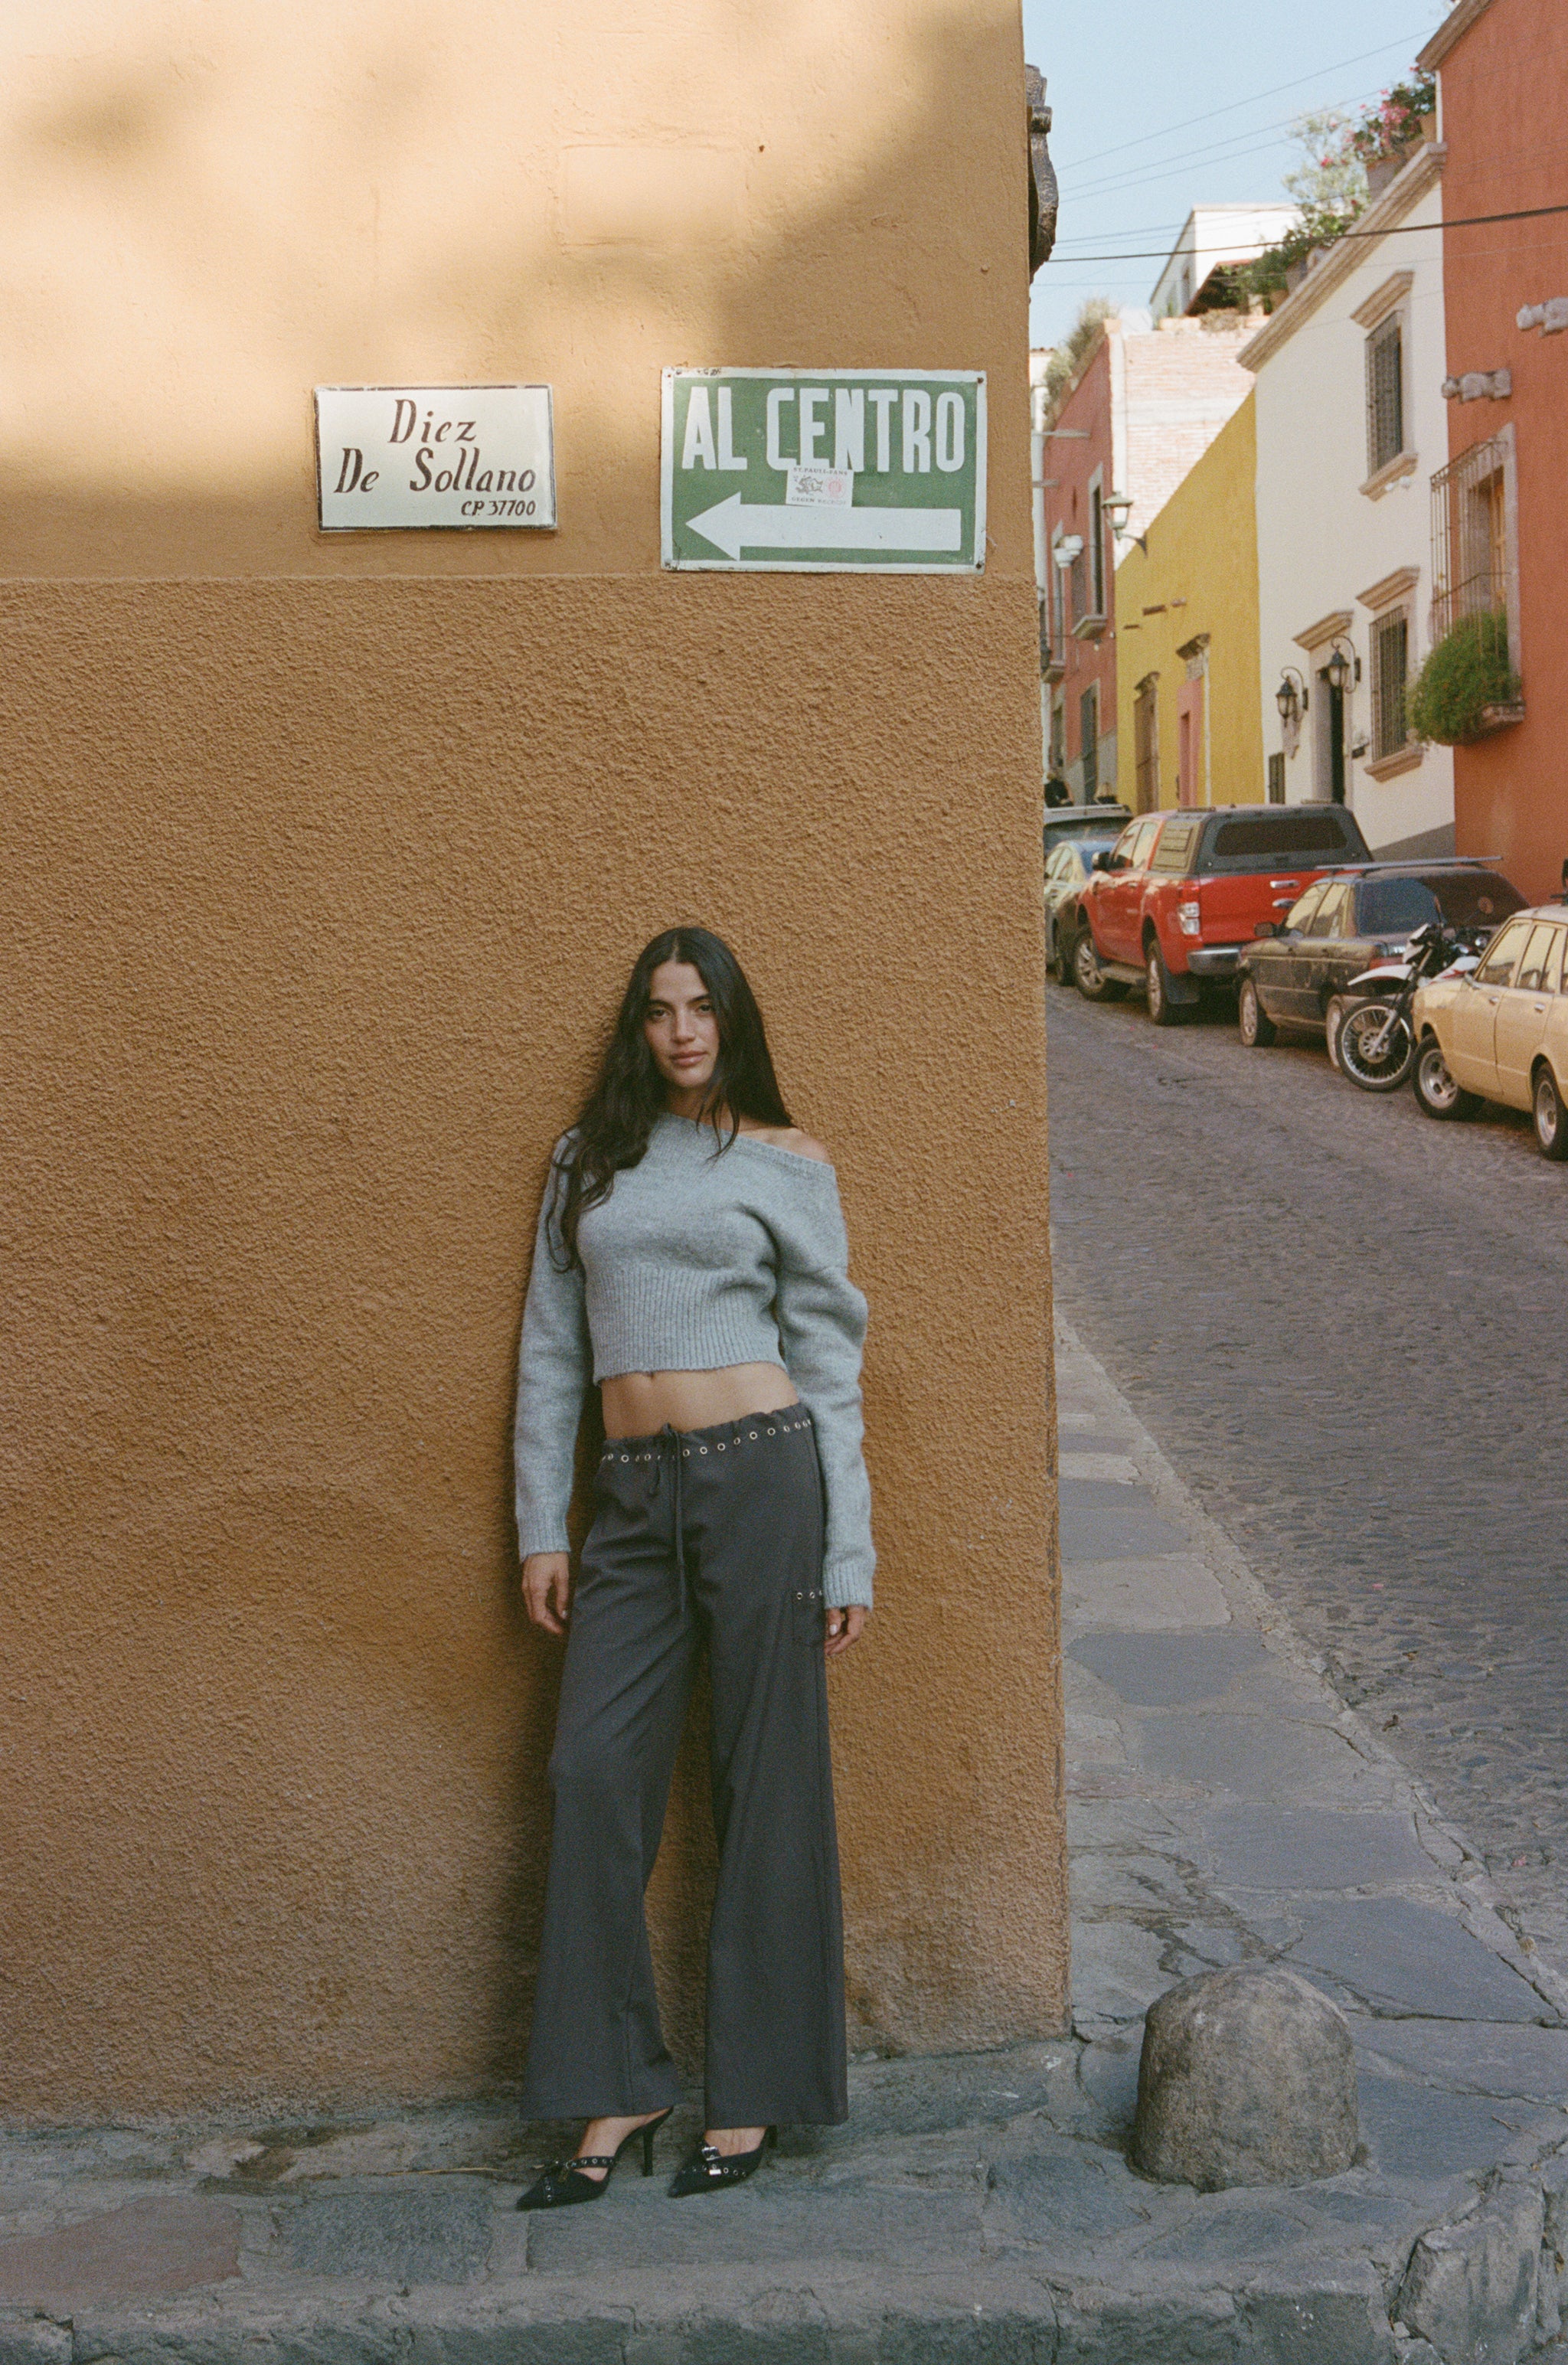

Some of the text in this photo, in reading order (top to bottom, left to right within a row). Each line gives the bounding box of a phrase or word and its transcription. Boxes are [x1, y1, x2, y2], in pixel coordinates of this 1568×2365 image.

[387, 399, 477, 443] Diez
[681, 386, 965, 473] AL CENTRO
[333, 446, 537, 493] De Sollano
[486, 500, 537, 517] 37700
